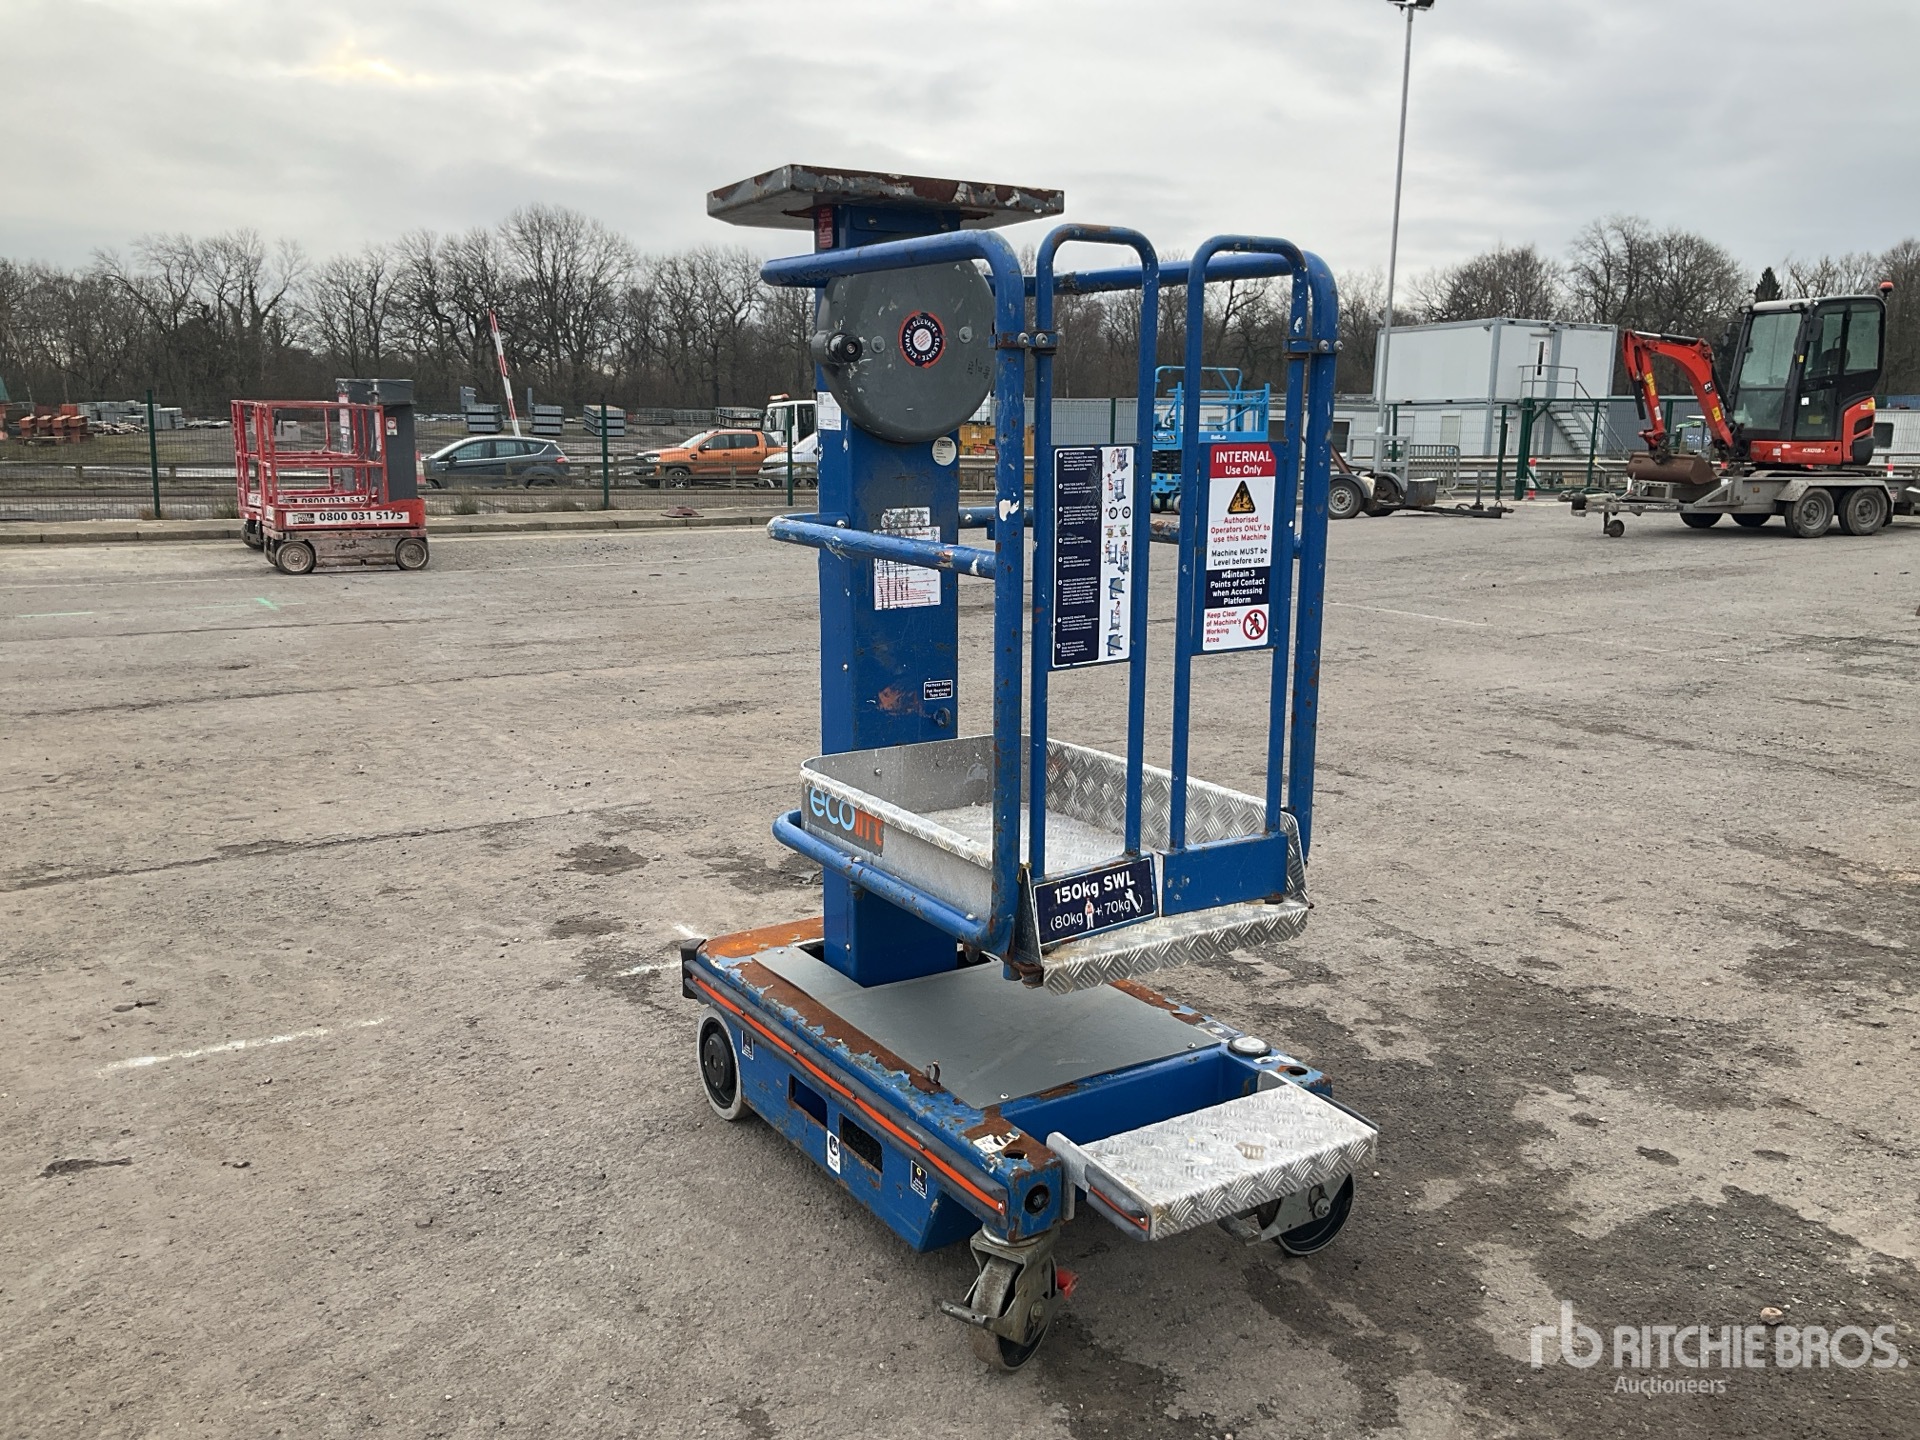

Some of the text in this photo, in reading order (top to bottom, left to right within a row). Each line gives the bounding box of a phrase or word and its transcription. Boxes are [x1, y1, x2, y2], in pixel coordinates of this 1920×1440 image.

[912, 319, 937, 332] ELEVATE
[905, 329, 918, 359] ELEVATE
[921, 337, 940, 362] ELEVATE
[1216, 450, 1272, 463] INTERNAL
[1225, 465, 1262, 475] Use Only
[319, 511, 403, 521] 0800 031 5175
[1224, 516, 1258, 524] Authorised
[1210, 526, 1242, 534] Operators
[1244, 524, 1262, 532] ONLY
[1211, 549, 1237, 557] Machine
[1214, 558, 1230, 566] Level
[1222, 570, 1249, 578] Maintain
[1210, 580, 1231, 588] Points
[1240, 578, 1265, 586] Contact
[1230, 587, 1262, 595] Accessing
[1223, 597, 1251, 605] Platform
[1054, 870, 1135, 904] 150kg SWL
[1050, 912, 1084, 931] (80kg
[1104, 899, 1131, 915] 70kg
